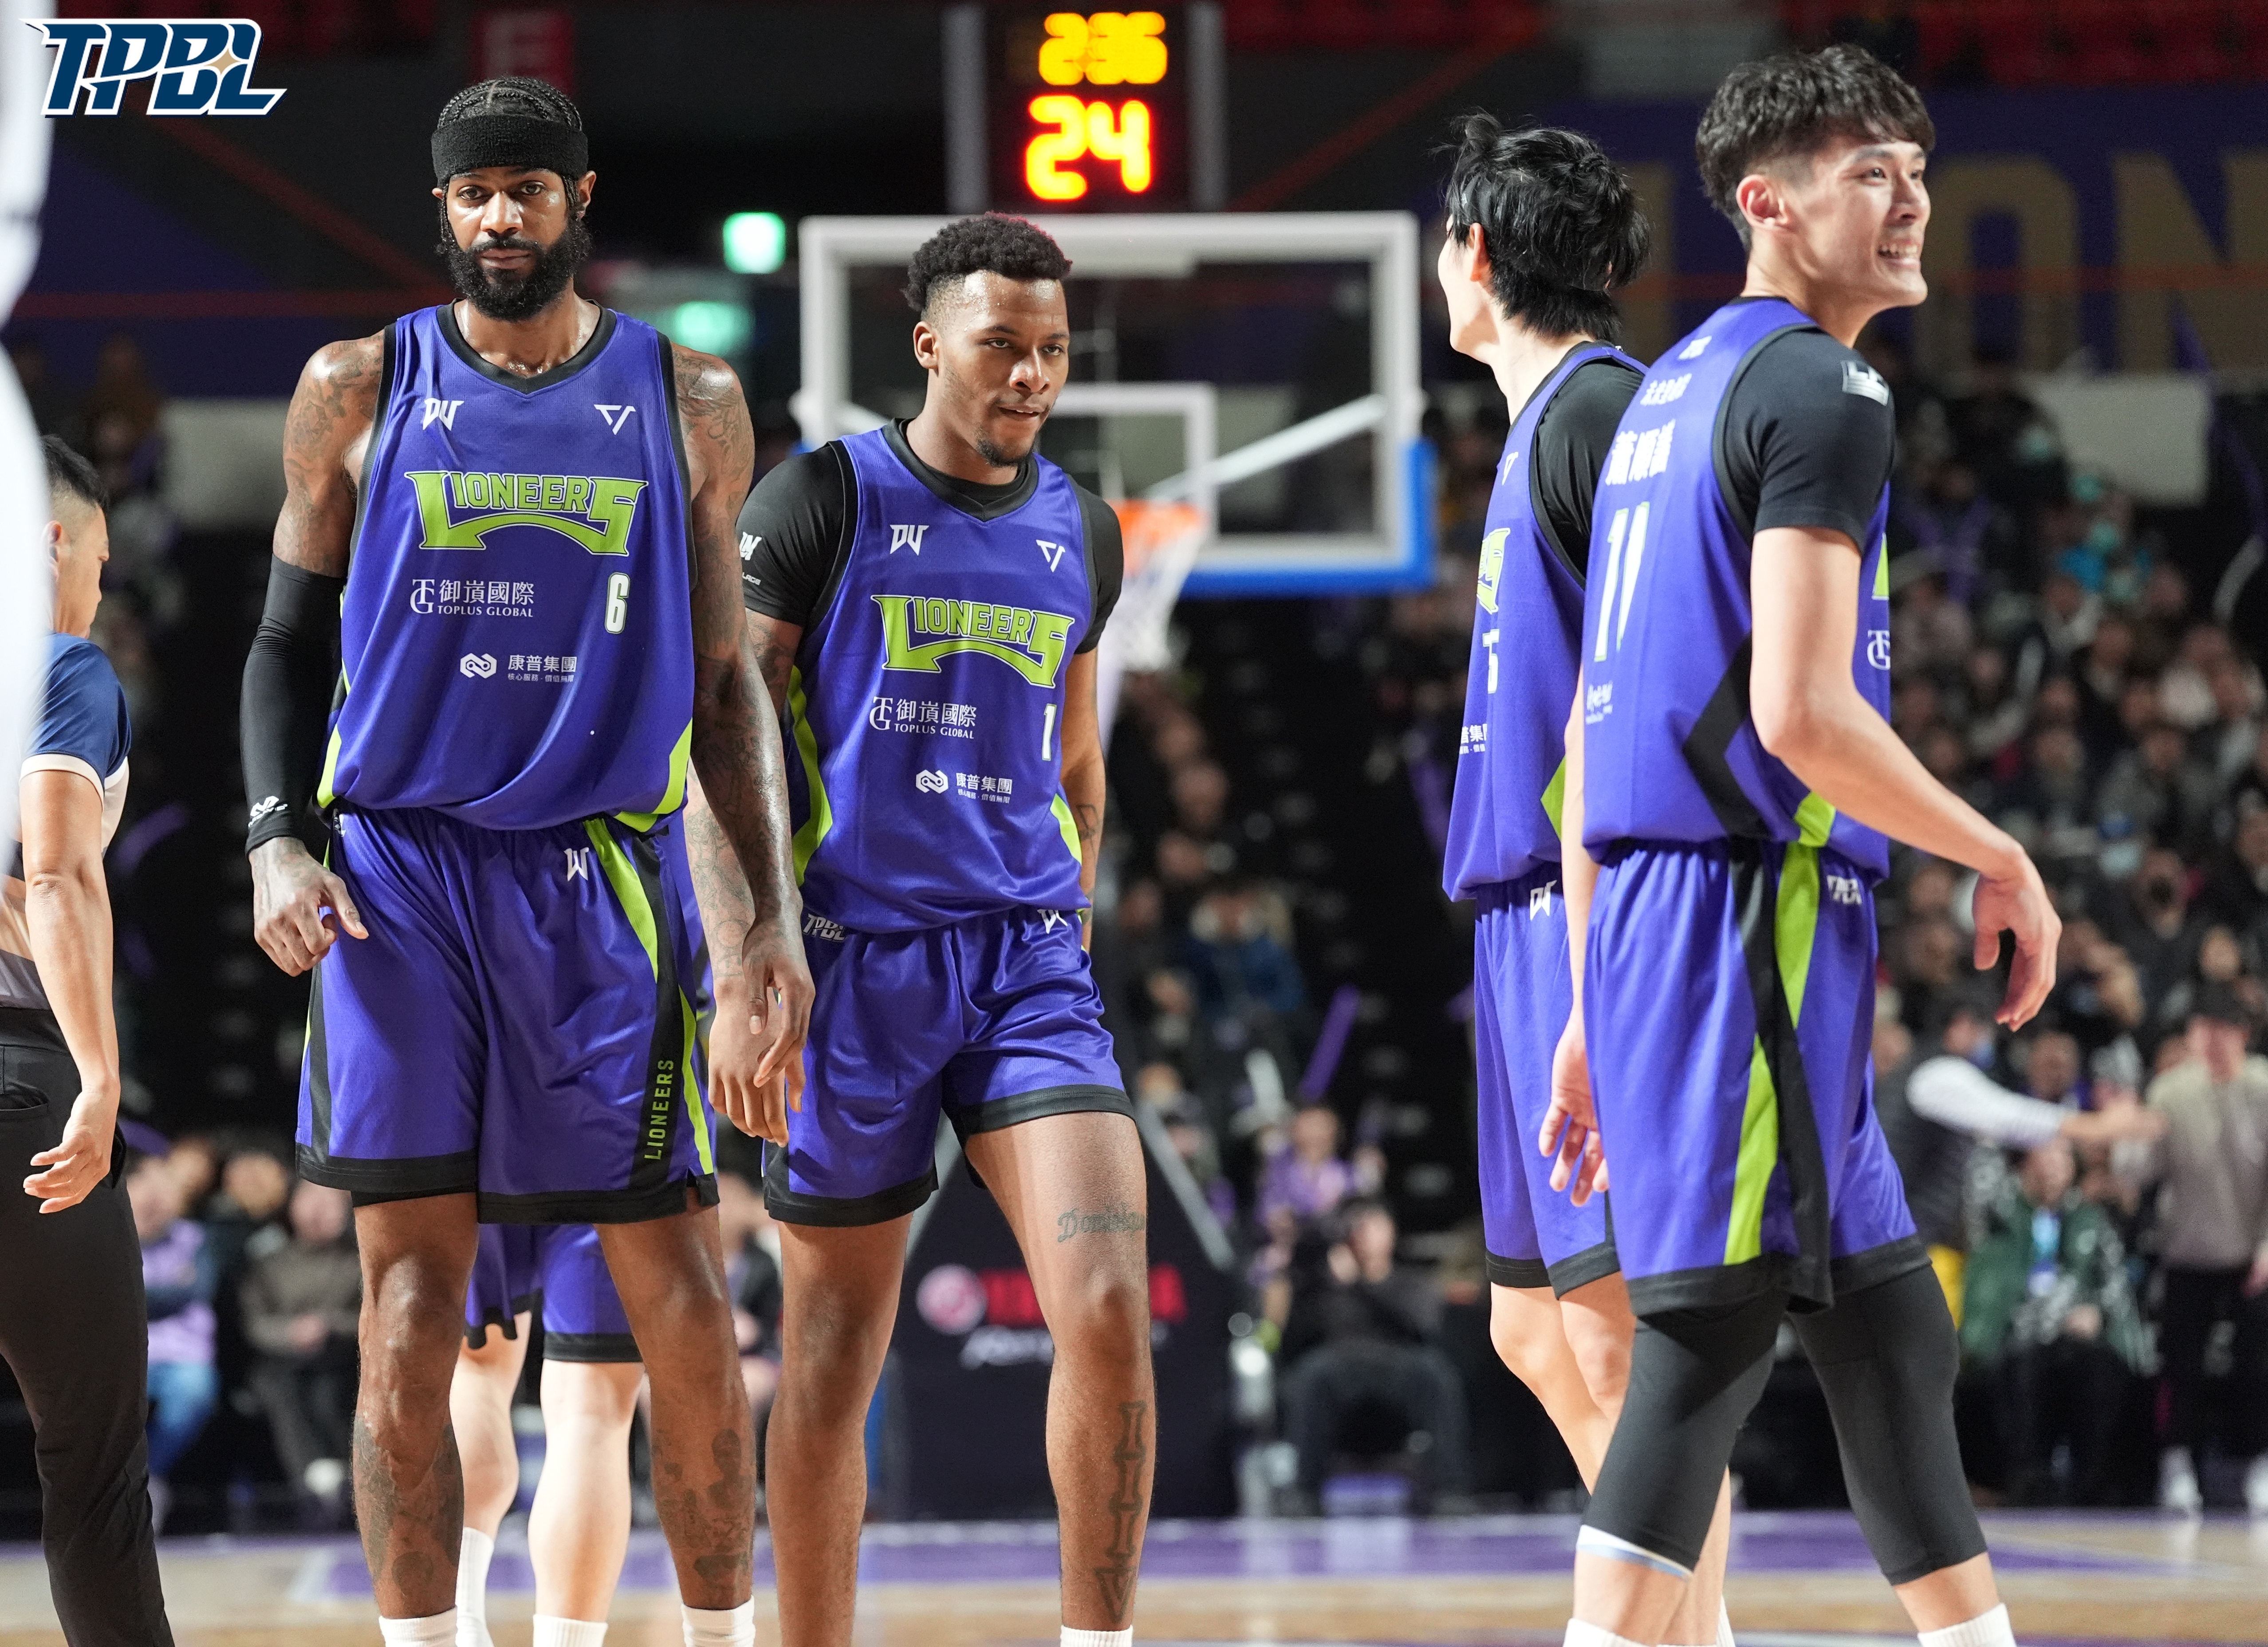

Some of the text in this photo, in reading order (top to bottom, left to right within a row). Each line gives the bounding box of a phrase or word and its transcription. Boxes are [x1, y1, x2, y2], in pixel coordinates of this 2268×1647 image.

[1026, 95, 1151, 200] 24
[404, 470, 649, 557] LIONEERS
[604, 572, 630, 634] 6
[742, 572, 761, 586] LAGE
[1594, 501, 1650, 662] 11
[437, 605, 534, 617] TOPLUS GLOBAL
[508, 654, 577, 673] 康普集團
[870, 594, 1075, 689] LIONEERS
[894, 723, 975, 739] TOPLUS GLOBAL
[1041, 703, 1057, 761] 1
[956, 772, 1013, 795] 康普集團
[803, 913, 847, 943] TPBL
[644, 1059, 674, 1160] LIONEERS
